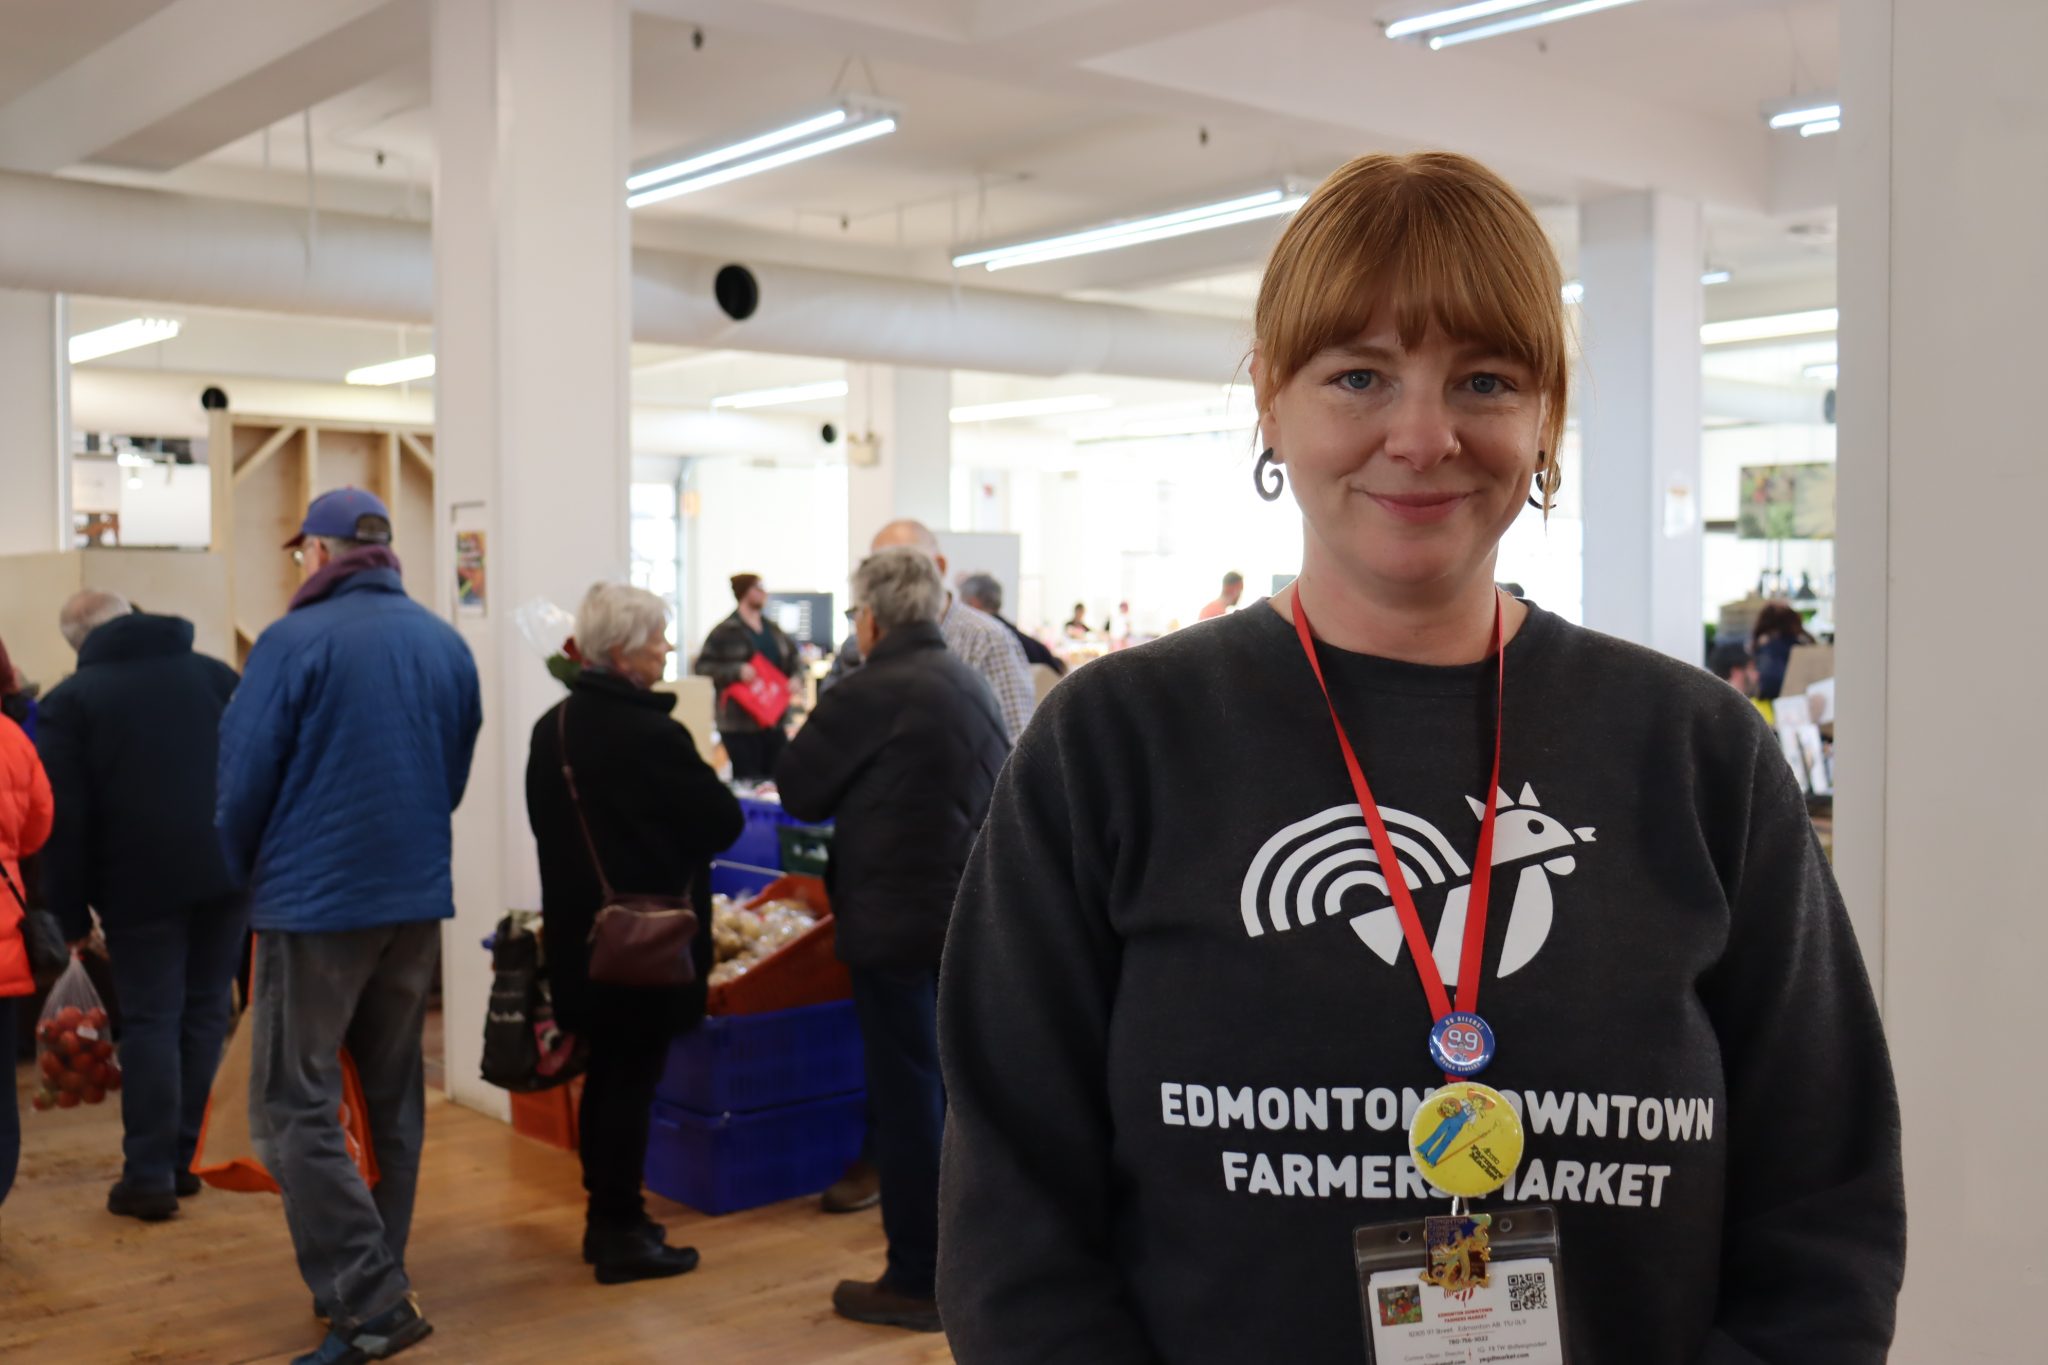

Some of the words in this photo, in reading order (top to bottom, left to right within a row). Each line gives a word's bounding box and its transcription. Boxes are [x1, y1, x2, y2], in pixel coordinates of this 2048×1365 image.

[1447, 1029, 1478, 1051] 99
[1222, 1151, 1447, 1198] FARMER
[1435, 1327, 1453, 1335] Street
[1458, 1322, 1490, 1333] Edmonton
